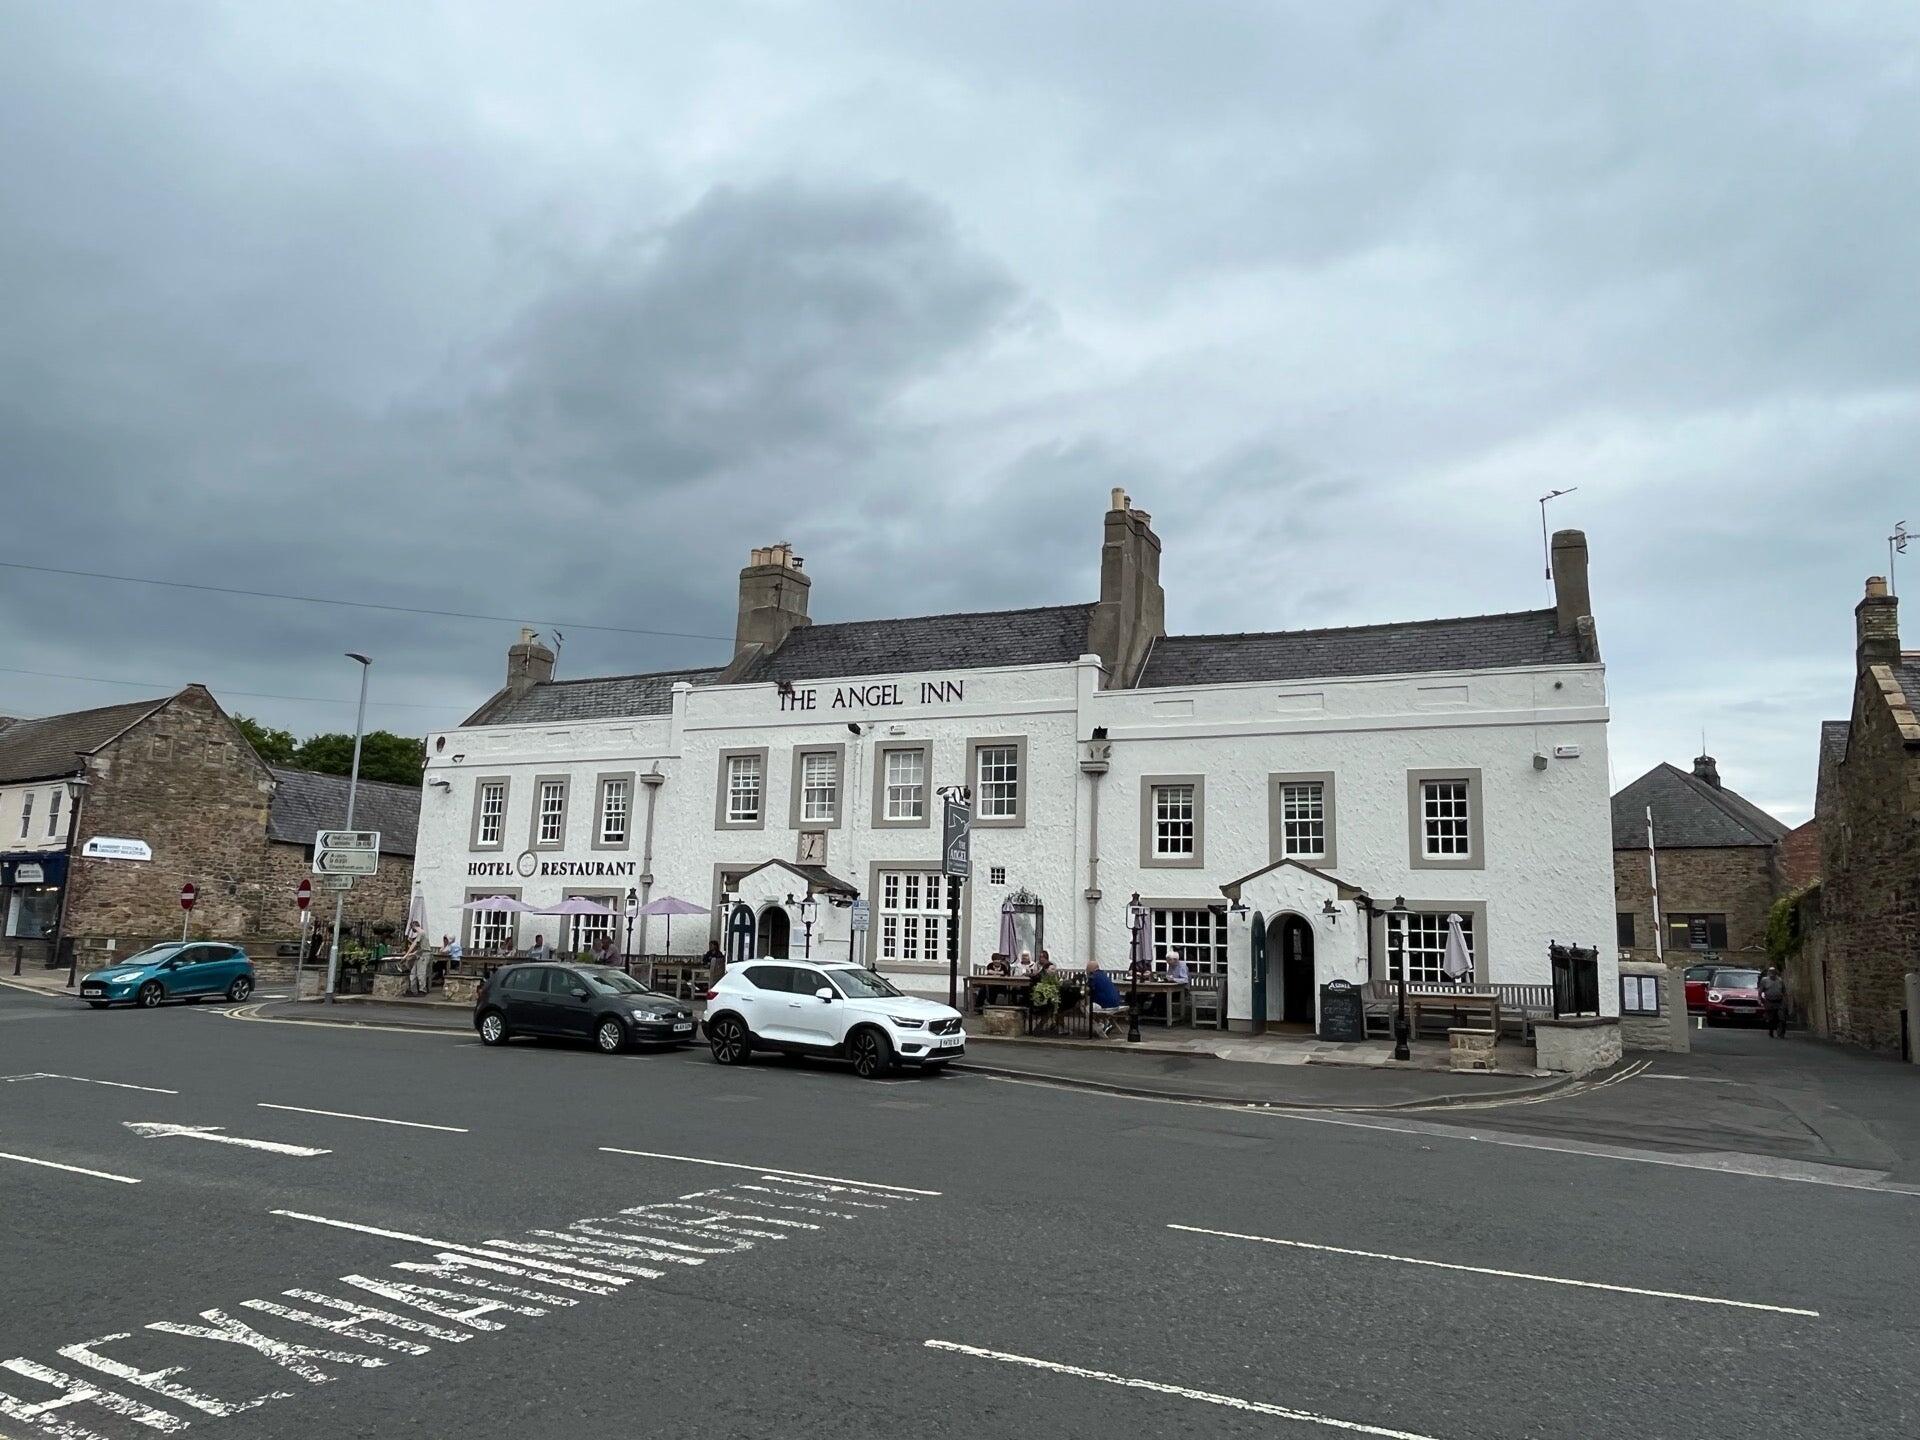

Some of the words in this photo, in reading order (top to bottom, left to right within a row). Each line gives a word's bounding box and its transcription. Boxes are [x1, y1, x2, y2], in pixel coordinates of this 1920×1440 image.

[778, 689, 816, 711] THE
[832, 684, 903, 709] ANGEL
[920, 680, 965, 704] INN
[467, 862, 513, 876] HOTEL
[540, 861, 637, 876] RESTAURANT
[482, 1175, 920, 1280] NORTH
[0, 1252, 618, 1440] HEXHAM
